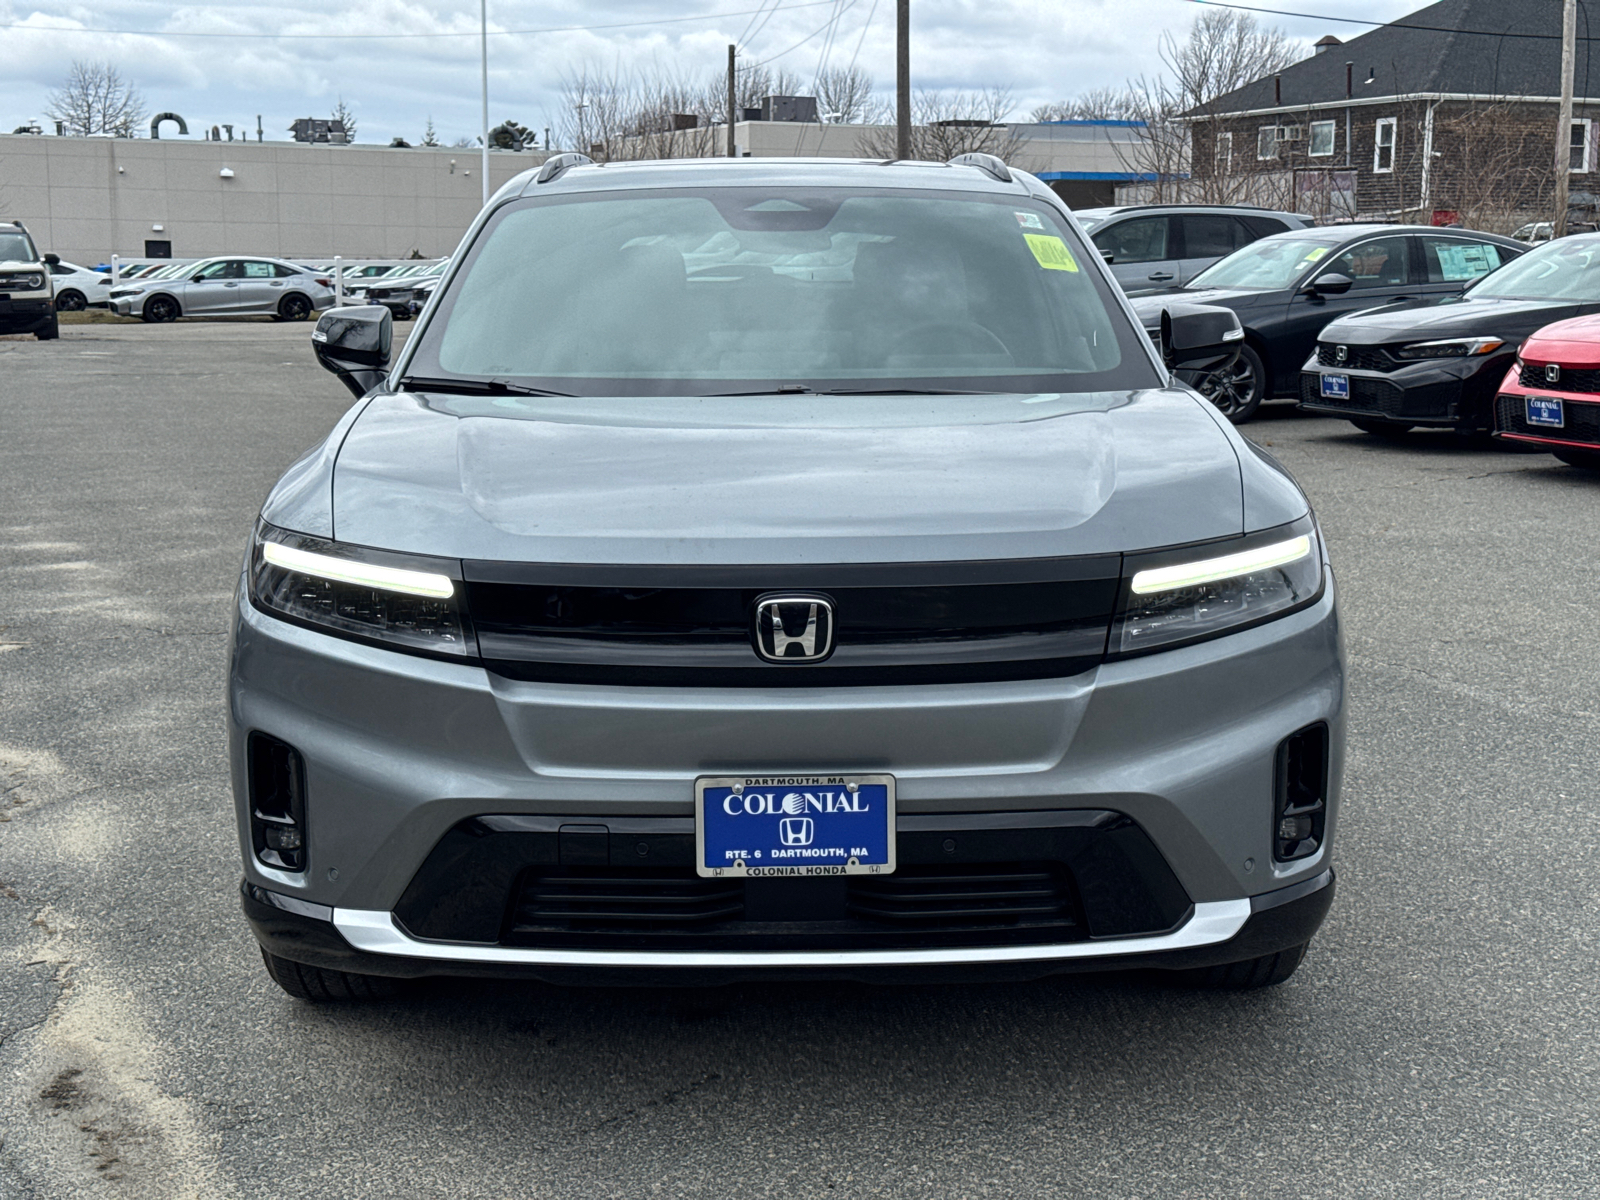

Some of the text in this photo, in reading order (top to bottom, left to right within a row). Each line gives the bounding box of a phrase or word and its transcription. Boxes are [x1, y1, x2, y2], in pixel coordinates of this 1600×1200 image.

[1530, 400, 1559, 410] COLONIAL
[827, 777, 845, 785] MA
[723, 791, 870, 816] COLONIAL
[725, 847, 869, 859] RTE. 6 DARTMOUTH, MA
[746, 866, 847, 877] COLONIAL HONDA
